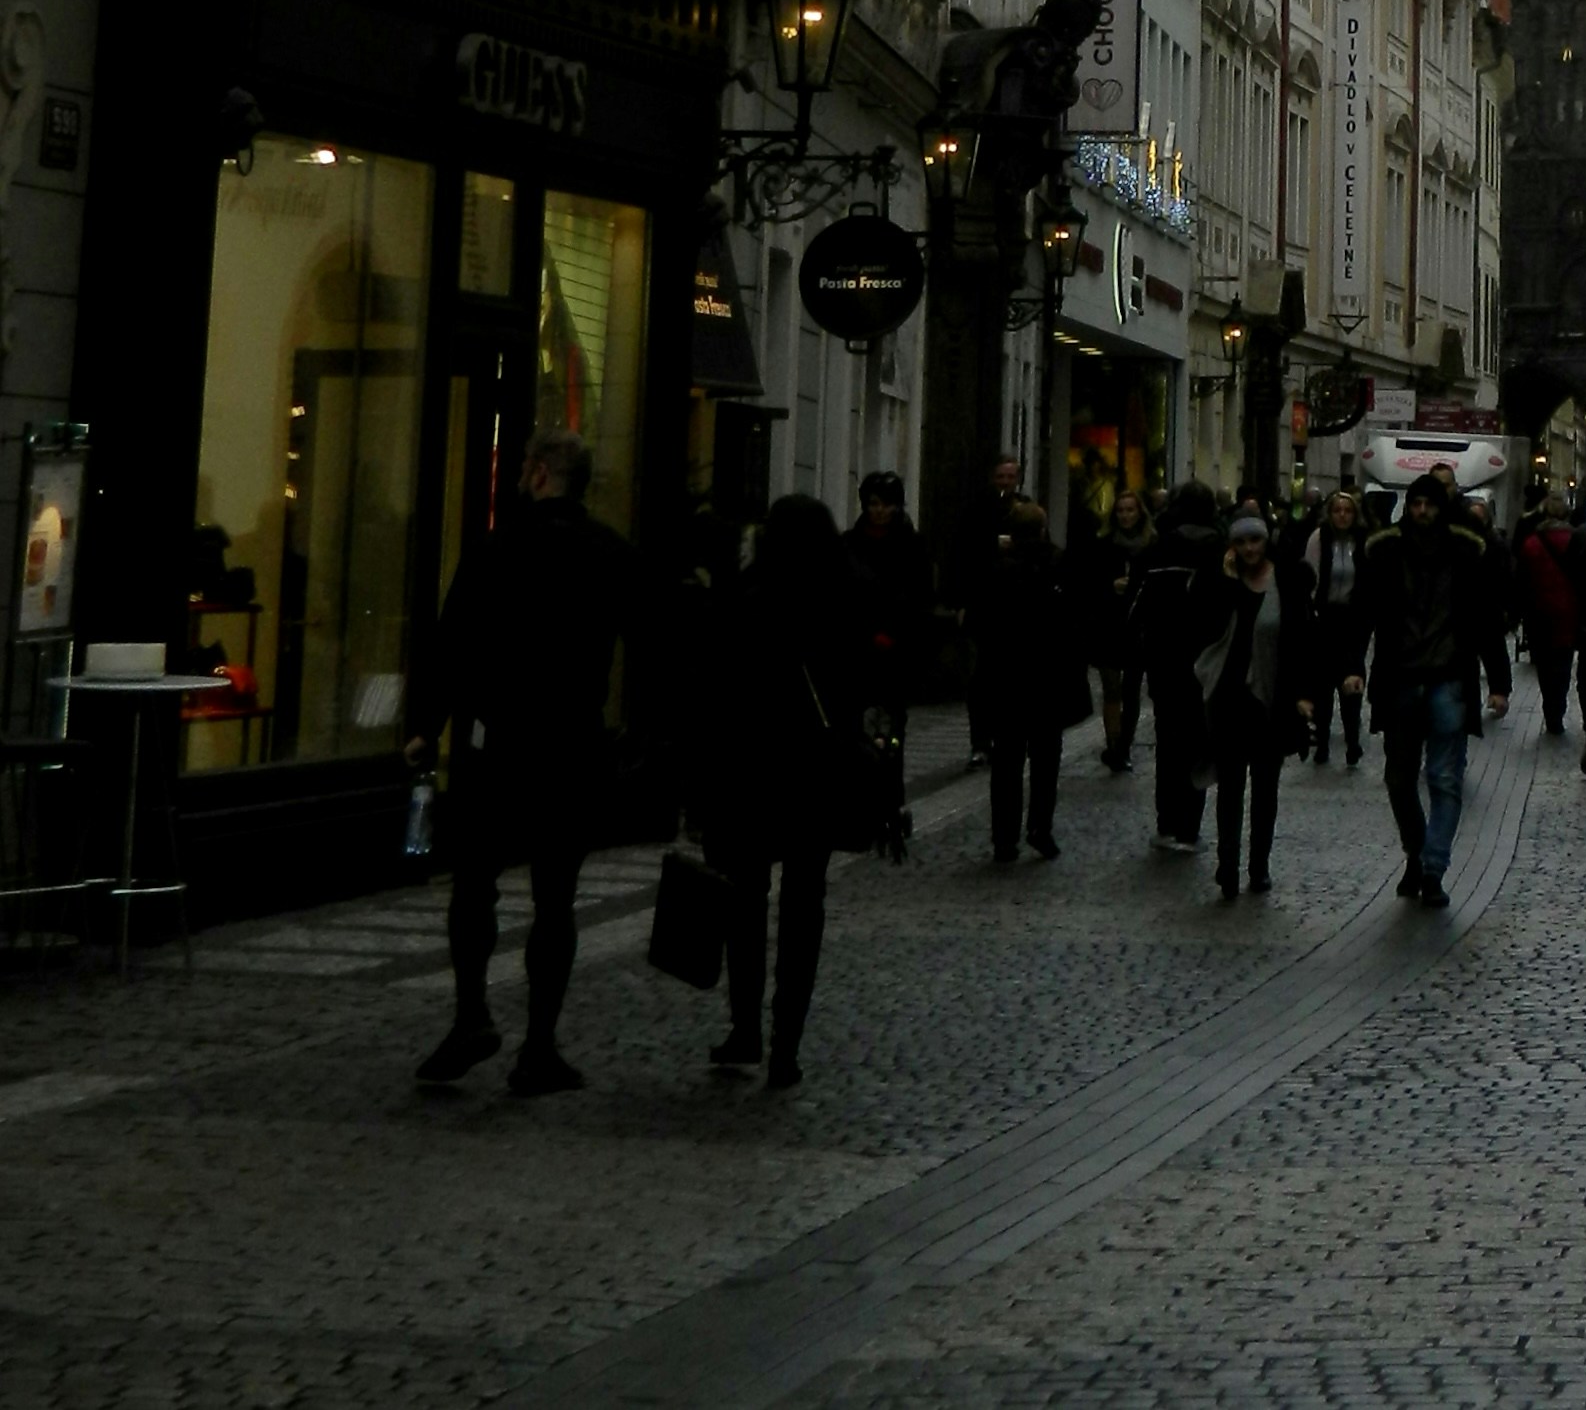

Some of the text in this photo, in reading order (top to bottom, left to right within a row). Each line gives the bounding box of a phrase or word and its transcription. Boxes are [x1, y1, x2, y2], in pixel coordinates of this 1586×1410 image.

[456, 31, 588, 138] GUESS
[1346, 17, 1360, 134] DIVADLO
[818, 275, 902, 289] Pasta Fresca
